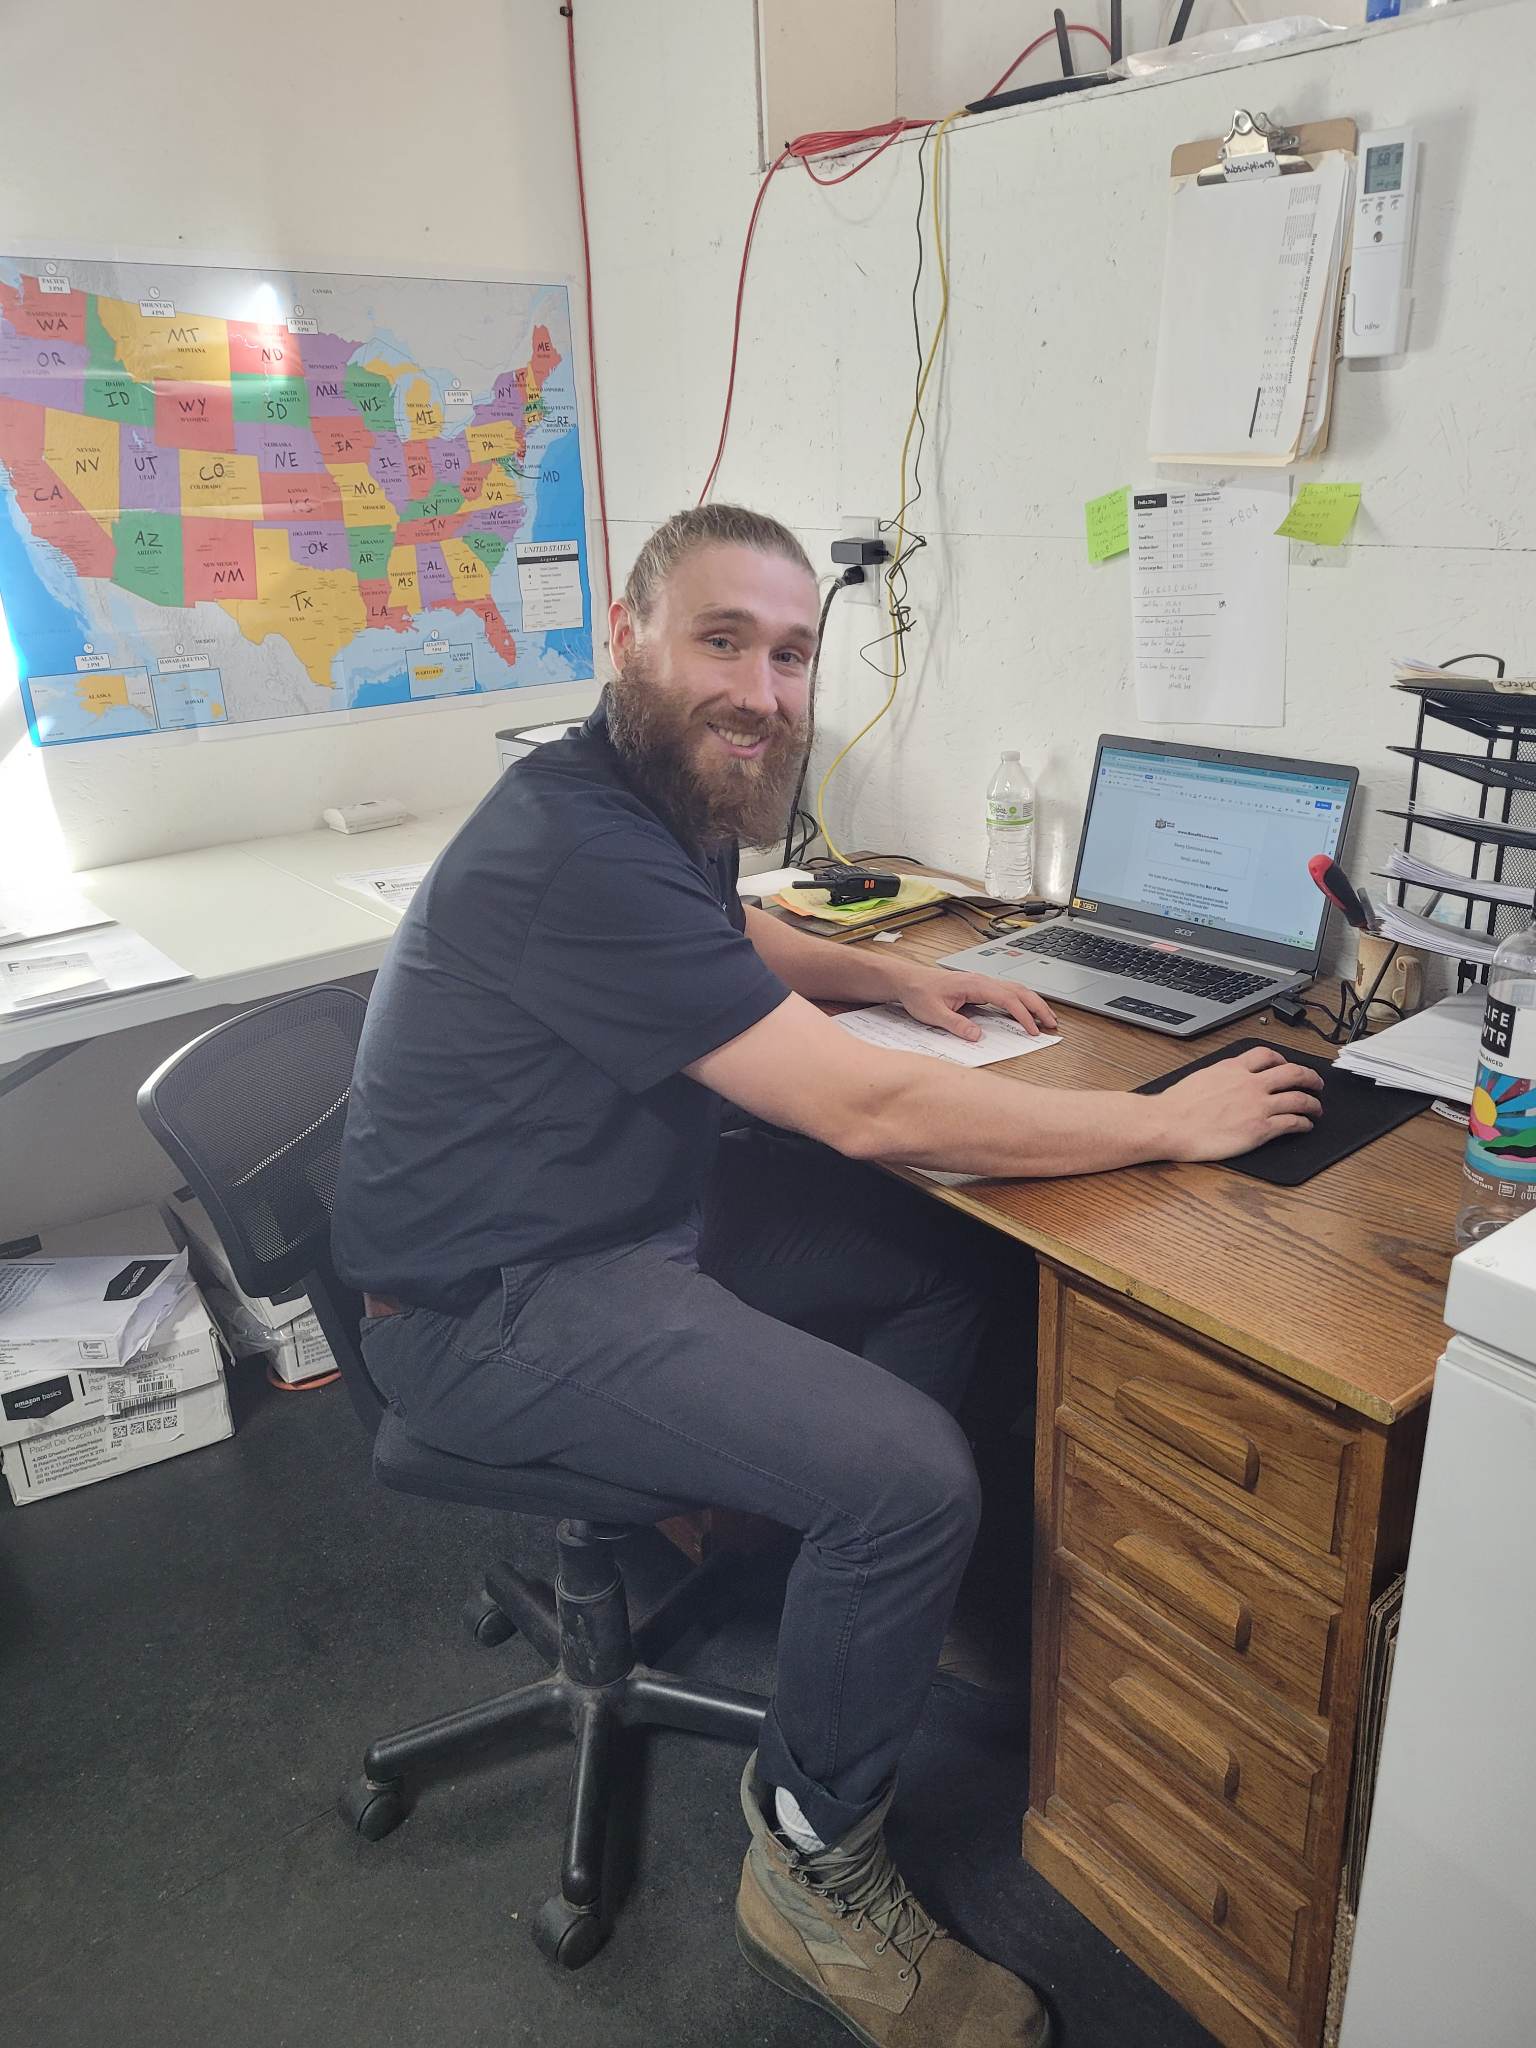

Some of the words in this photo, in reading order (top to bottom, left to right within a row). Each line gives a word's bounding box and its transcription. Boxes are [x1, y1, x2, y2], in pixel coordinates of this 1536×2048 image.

[1306, 255, 1314, 275] Maine
[36, 318, 69, 332] WA
[167, 327, 200, 344] MT
[537, 341, 551, 352] ME
[37, 351, 66, 367] OR
[261, 348, 284, 362] ND
[515, 372, 525, 383] VT
[315, 383, 338, 397] MN
[498, 387, 512, 399] NY
[528, 392, 540, 401] NH
[104, 391, 130, 408] ID
[179, 397, 207, 416] WY
[359, 396, 382, 413] WI
[266, 401, 288, 420] SD
[525, 403, 538, 412] MA
[415, 410, 437, 425] MI
[556, 415, 569, 427] RI
[334, 439, 353, 453] IA
[482, 440, 495, 452] PA
[75, 455, 100, 475] NV
[134, 455, 158, 475] UT
[275, 451, 300, 469] NE
[378, 457, 397, 469] IL
[444, 458, 461, 470] OH
[199, 462, 225, 481] CO
[408, 463, 426, 477] IN
[542, 470, 560, 484] MD
[34, 485, 63, 501] CA
[354, 481, 376, 496] MO
[462, 486, 477, 494] WV
[486, 491, 503, 501] VA
[422, 499, 439, 516] KY
[489, 510, 505, 520] NC
[428, 518, 447, 532] TN
[134, 530, 164, 548] AZ
[473, 538, 486, 549] SC
[308, 541, 329, 556] OK
[523, 544, 547, 554] UNITED
[547, 543, 572, 552] STATES
[359, 553, 374, 565] AR
[427, 560, 442, 572] AL
[458, 562, 477, 574] GA
[213, 568, 246, 584] NM
[398, 577, 414, 588] MS
[371, 605, 388, 617] LA
[484, 611, 498, 622] FL
[80, 655, 105, 663] ALASKA
[374, 881, 386, 890] P
[1174, 927, 1196, 937] acer
[14, 1396, 41, 1409] amazon
[41, 1389, 62, 1401] basics
[29, 1440, 53, 1454] Papel
[54, 1436, 67, 1447] De
[67, 1429, 93, 1443] Copia
